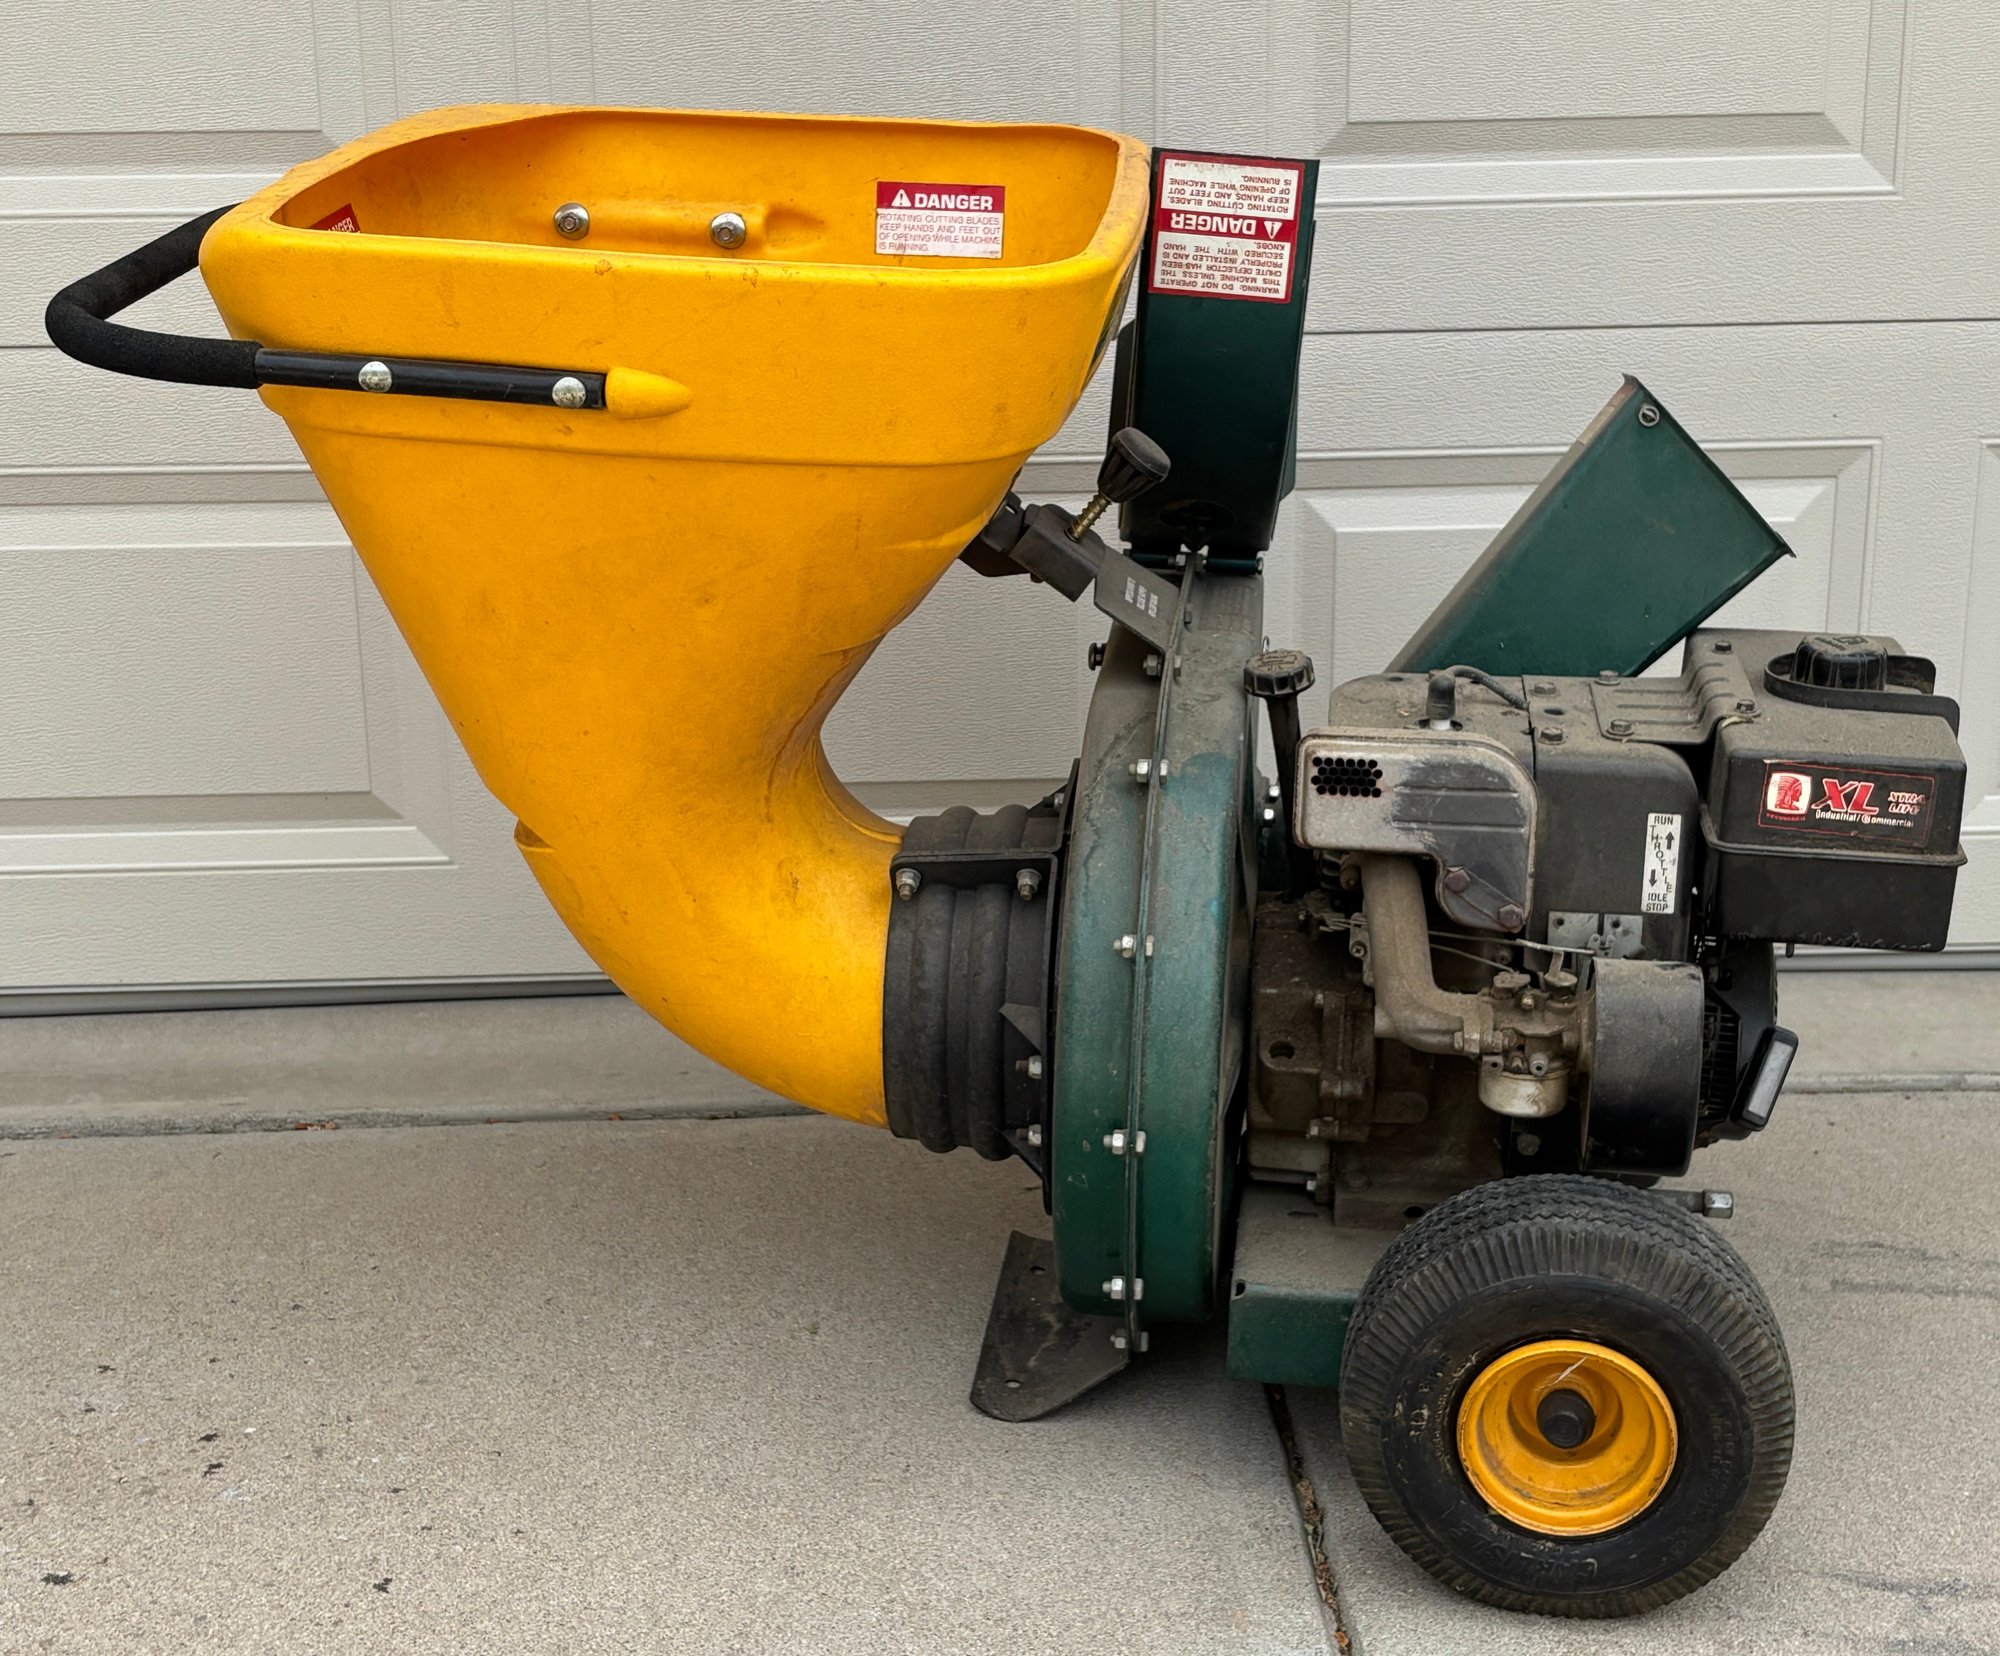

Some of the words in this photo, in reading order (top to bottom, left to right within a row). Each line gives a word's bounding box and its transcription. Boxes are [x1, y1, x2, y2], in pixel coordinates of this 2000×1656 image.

[1169, 178, 1206, 188] MACHINE
[1241, 175, 1280, 185] RUNNING.
[1210, 182, 1237, 191] WHILE
[1240, 184, 1276, 194] OPENING
[1215, 191, 1231, 199] AND
[1236, 194, 1264, 202] HANDS
[914, 193, 993, 211] DANGER
[1168, 196, 1202, 206] BLADES.
[1207, 200, 1244, 209] CUTTING
[1267, 196, 1290, 204] KEEP
[1248, 204, 1288, 213] ROTATING
[879, 213, 922, 222] ROTATING
[925, 215, 964, 224] CUTTING
[880, 222, 901, 231] KEEP
[904, 224, 934, 232] HANDS
[937, 225, 956, 234] AND
[959, 226, 980, 234] FEET
[983, 226, 1001, 235] OUT
[1171, 213, 1257, 235] DANGER
[879, 232, 891, 240] OF
[892, 233, 931, 242] OPENING
[933, 233, 959, 243] WHILE
[961, 235, 1001, 244] MACHINE
[879, 241, 887, 250] IS
[1163, 243, 1186, 251] HAND
[1254, 242, 1285, 250] KNOBS.
[1218, 248, 1238, 256] WITH
[1245, 251, 1284, 259] SECURED
[1192, 255, 1237, 264] INSTALLED
[1240, 260, 1283, 268] PROPERLY
[1185, 262, 1201, 270] HAS
[1206, 265, 1253, 274] DEFLECTOR
[1161, 269, 1176, 277] THE
[1182, 271, 1215, 280] UNLESS
[1255, 269, 1282, 277] CHUTE
[1160, 278, 1197, 288] OPERATE
[1220, 274, 1257, 283] MACHINE
[1201, 281, 1218, 289] NOT
[1240, 285, 1280, 294] WARNING:
[1811, 778, 1879, 814] XL
[1654, 815, 1674, 825] RUN
[1648, 892, 1668, 902] IDLE
[1646, 902, 1668, 912] STOP
